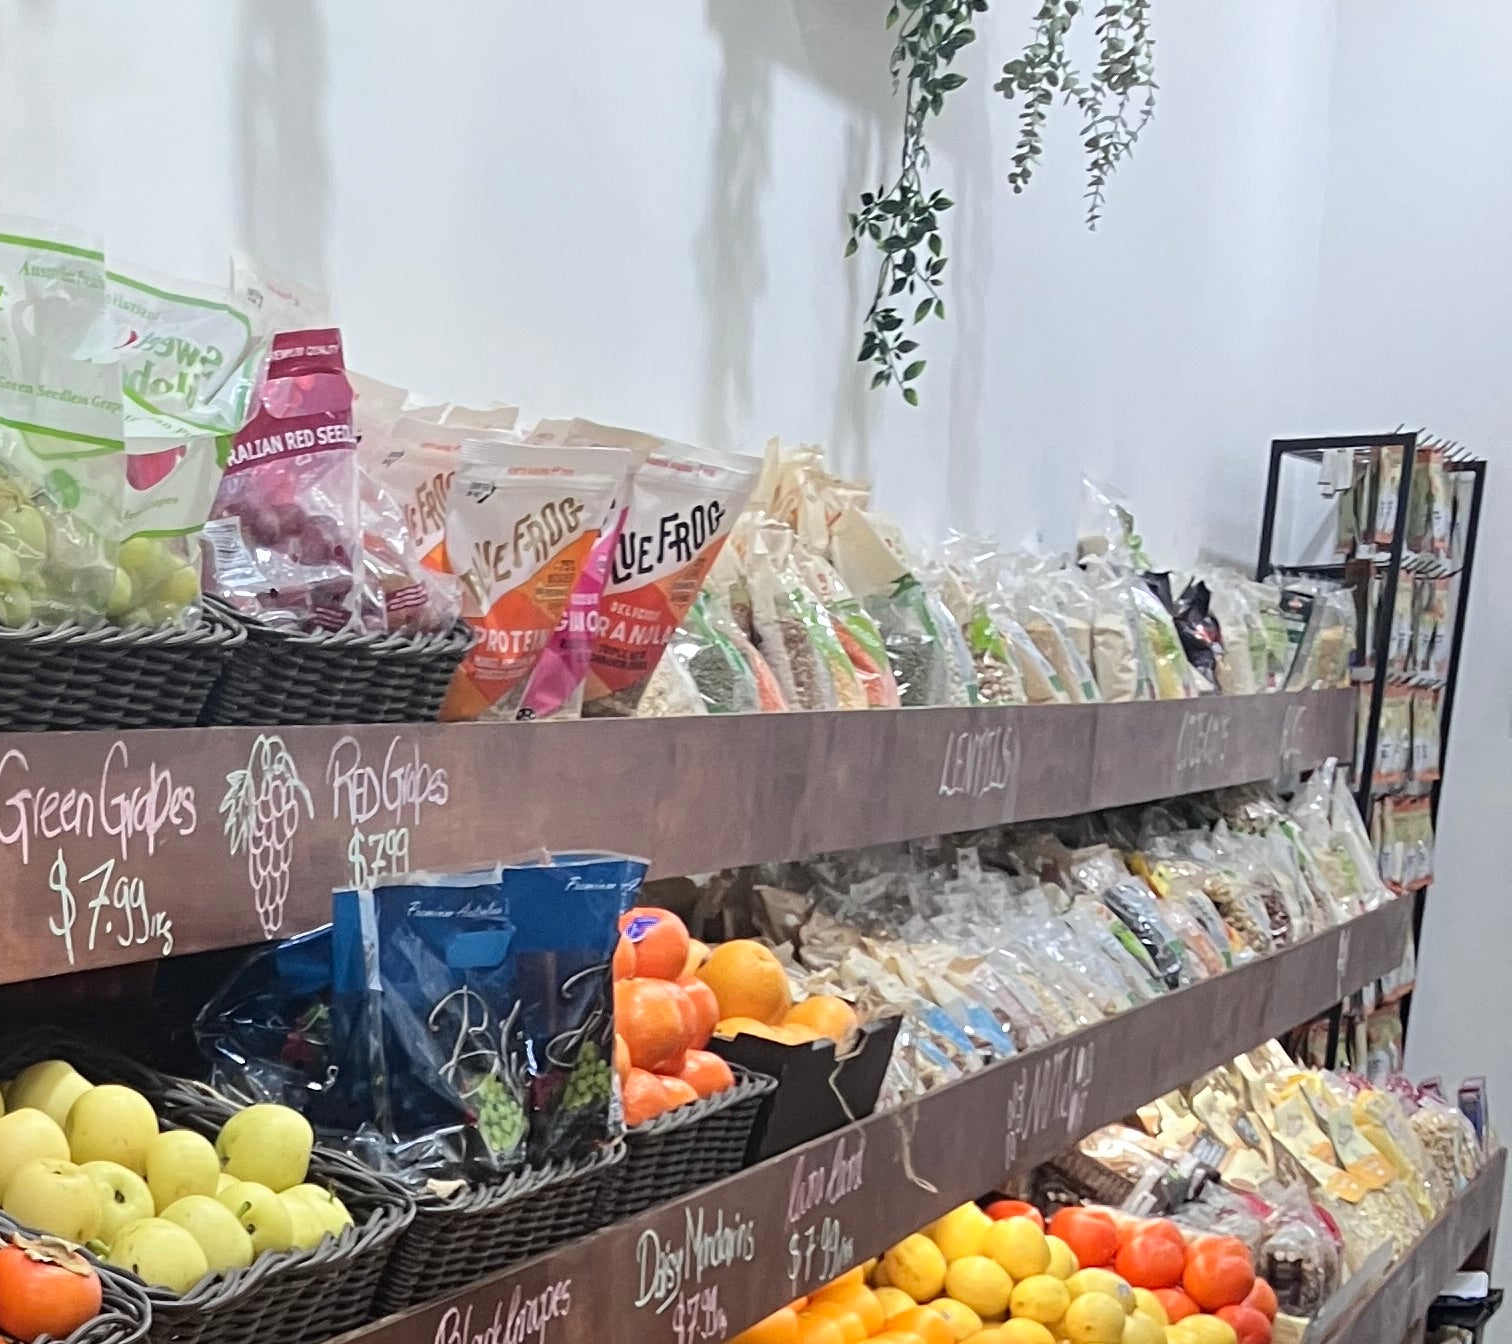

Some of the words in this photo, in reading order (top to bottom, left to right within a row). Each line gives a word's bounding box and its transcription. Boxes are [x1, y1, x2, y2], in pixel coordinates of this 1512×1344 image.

[228, 435, 282, 467] RALIAN
[285, 428, 314, 451] RED
[657, 499, 726, 564] FROG
